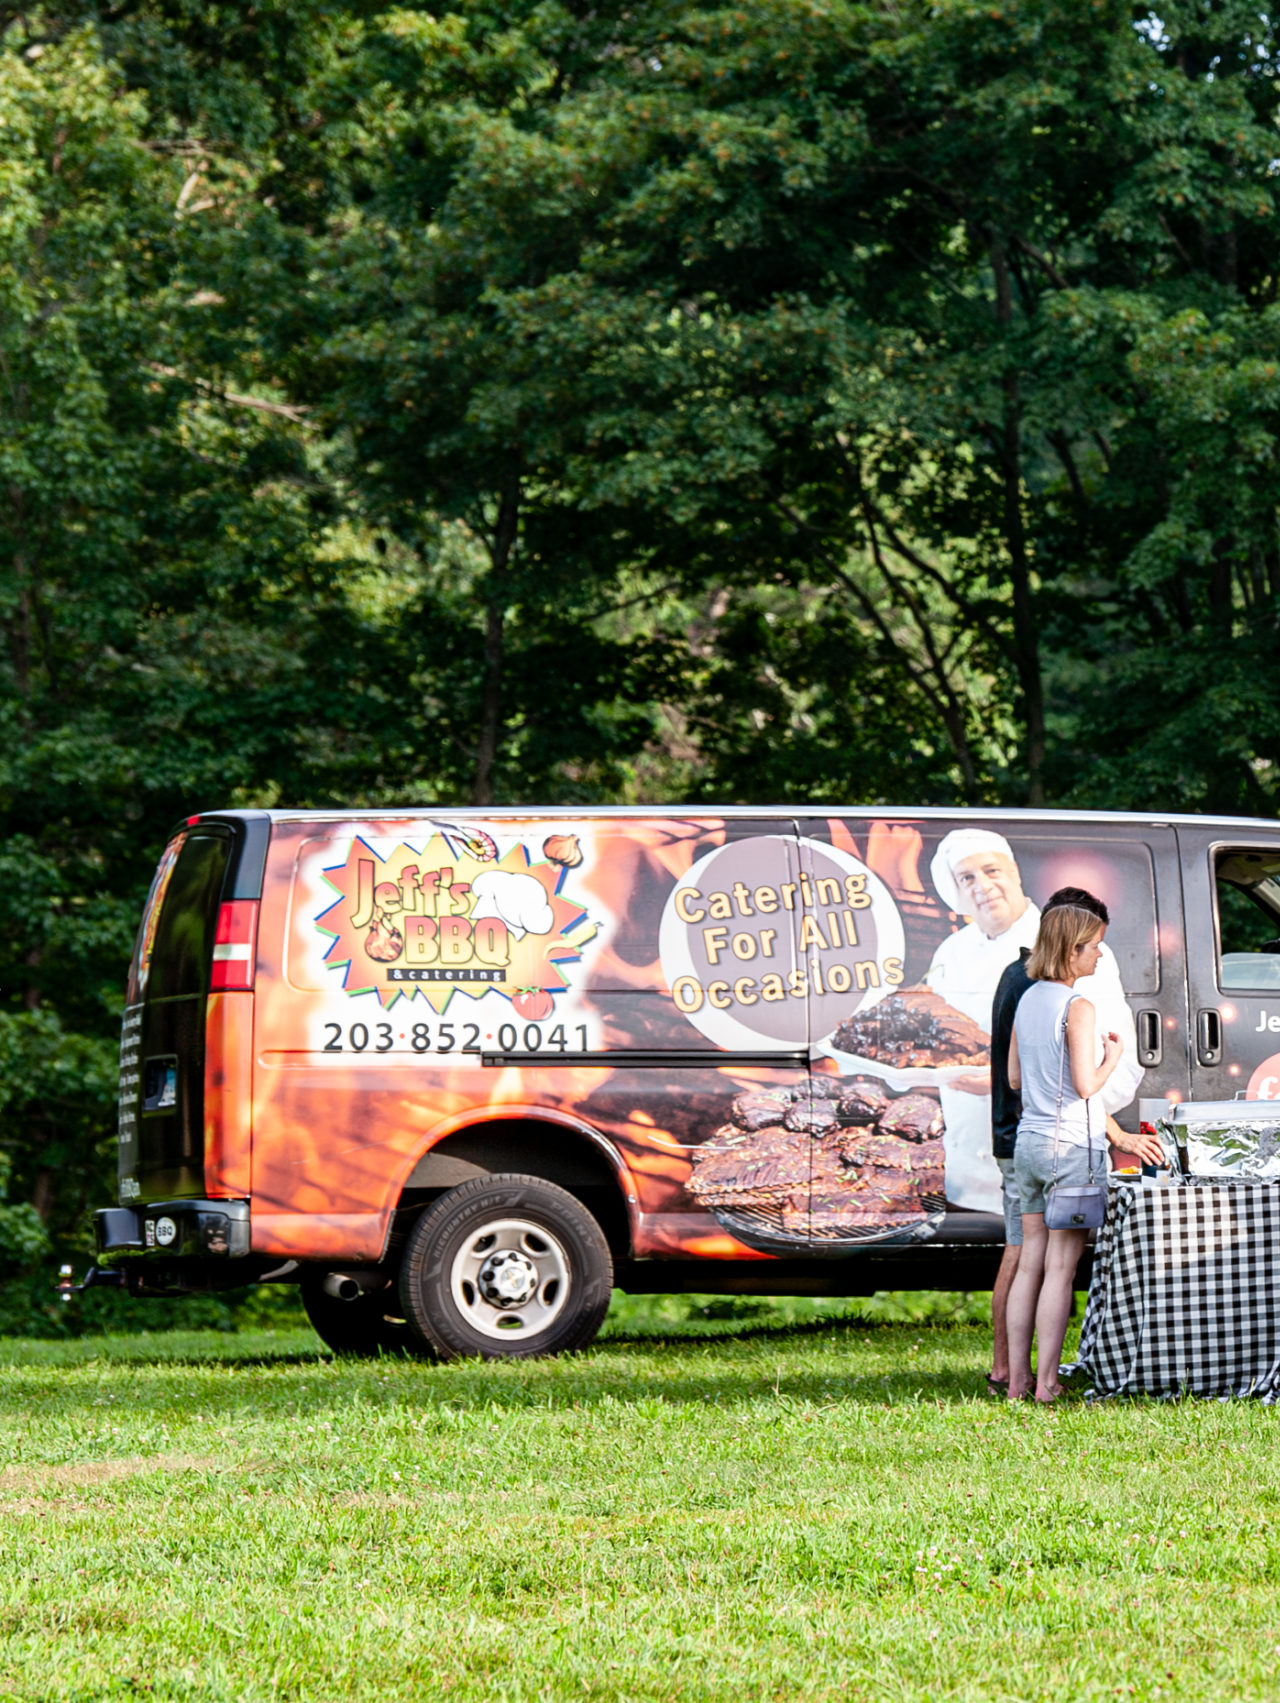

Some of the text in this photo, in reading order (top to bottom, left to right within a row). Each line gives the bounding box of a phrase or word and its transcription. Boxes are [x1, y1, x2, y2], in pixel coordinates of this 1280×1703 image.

[350, 858, 471, 929] Jeff's
[674, 872, 872, 924] Catering
[404, 915, 511, 967] BBQ
[703, 910, 859, 964] For All
[671, 957, 905, 1013] Occasions
